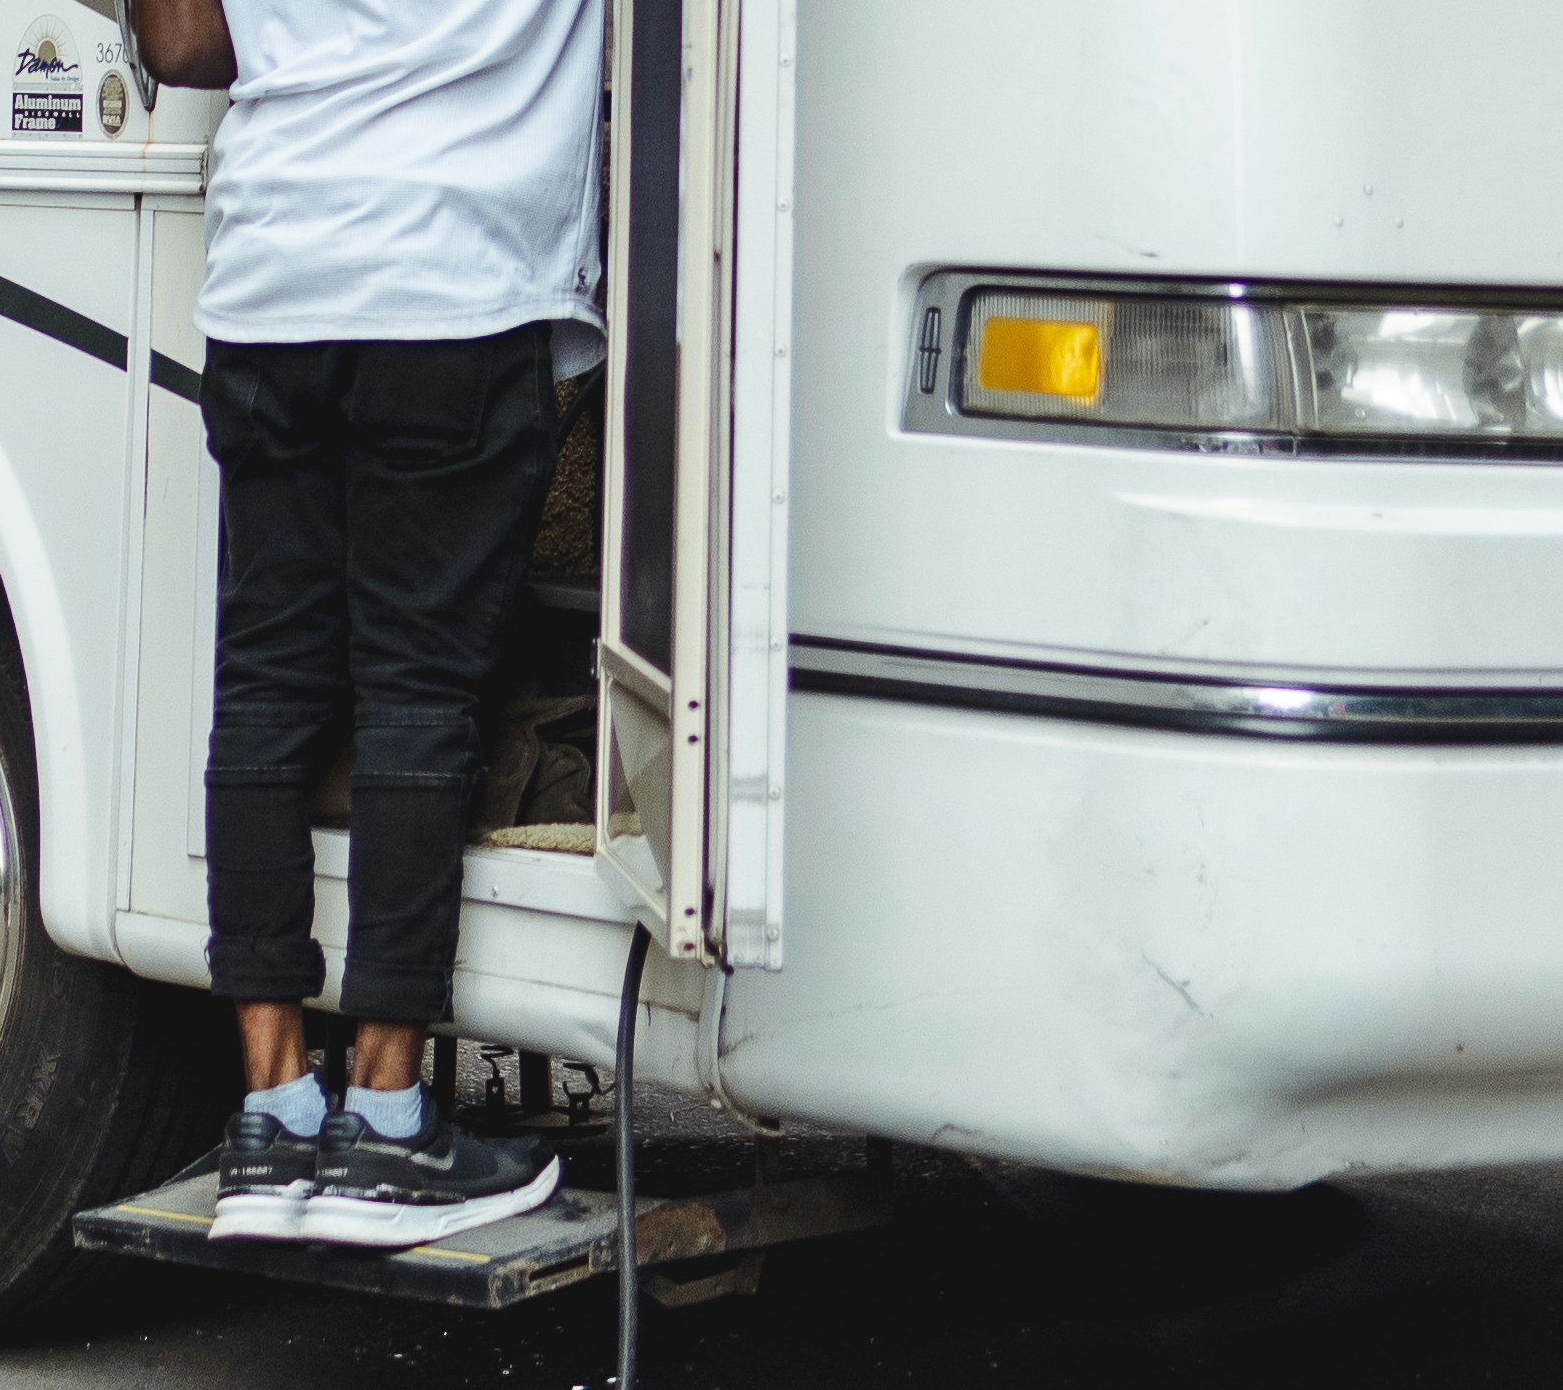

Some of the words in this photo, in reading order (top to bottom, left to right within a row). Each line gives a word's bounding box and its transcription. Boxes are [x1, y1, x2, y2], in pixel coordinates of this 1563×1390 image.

[15, 47, 79, 79] Damon
[14, 94, 81, 110] Aluminum
[14, 113, 56, 130] Frame
